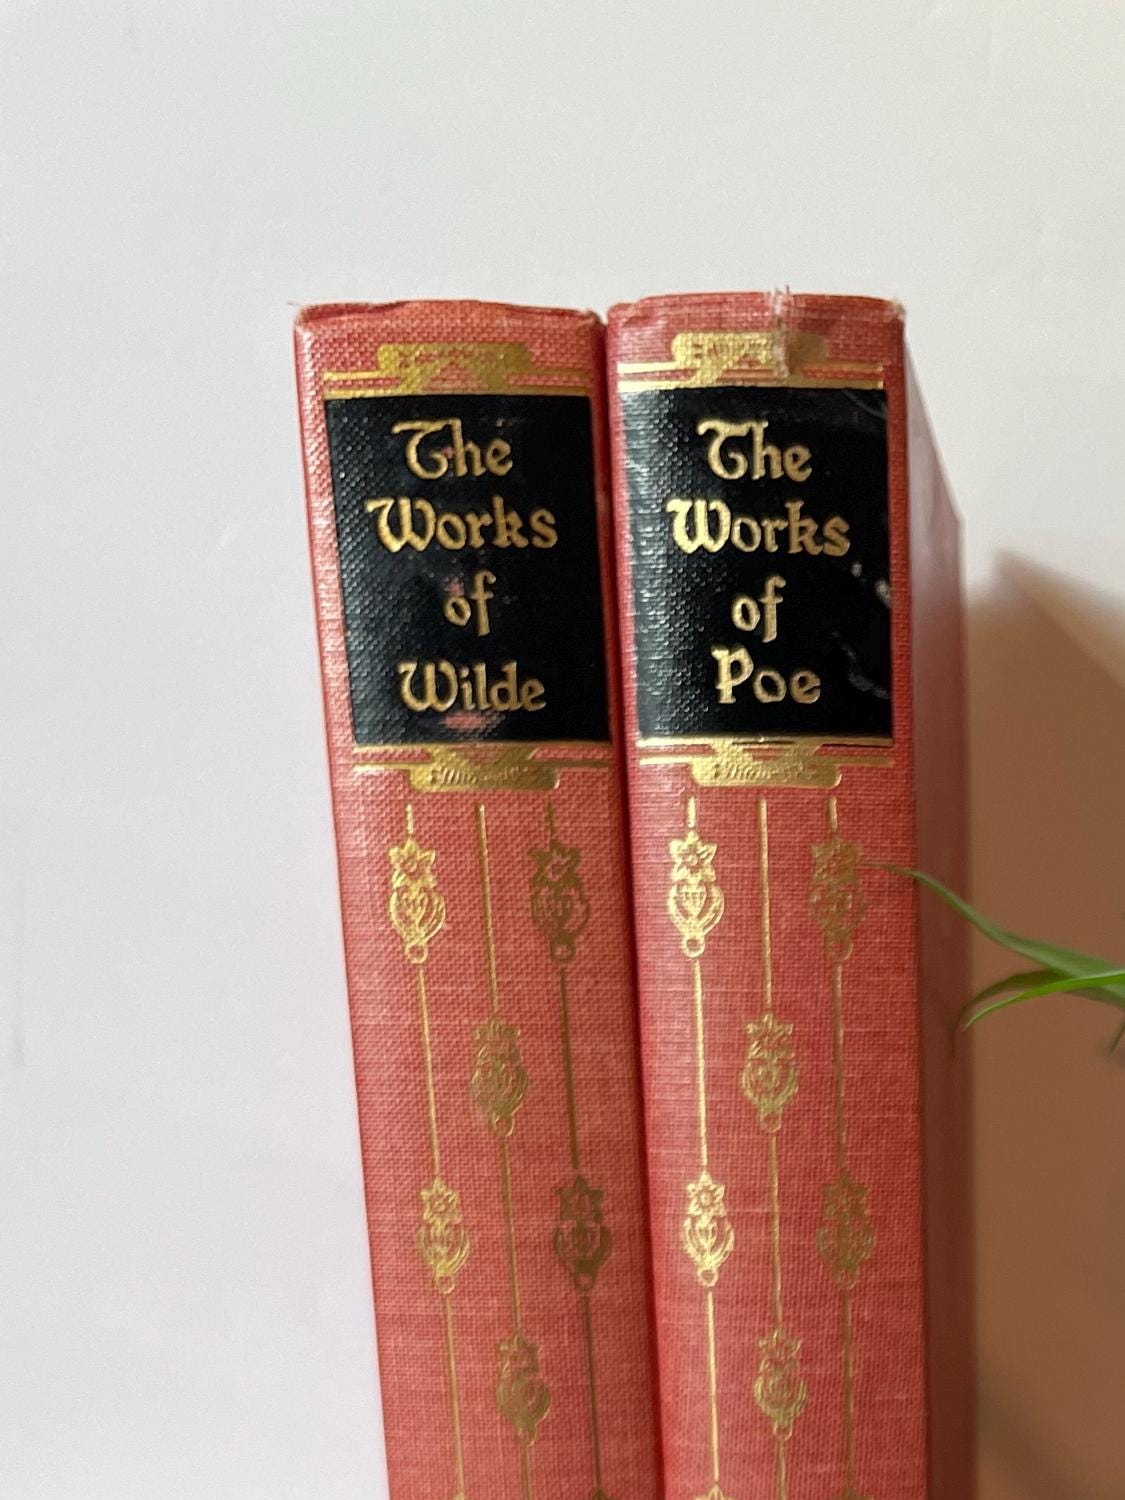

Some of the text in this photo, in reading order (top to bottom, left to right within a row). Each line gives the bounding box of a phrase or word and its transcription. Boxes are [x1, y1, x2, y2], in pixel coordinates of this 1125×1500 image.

[390, 418, 514, 480] The
[697, 420, 813, 481] The
[366, 496, 558, 553] Works
[667, 499, 850, 556] Works
[445, 570, 496, 635] of
[731, 576, 785, 643] of
[399, 660, 546, 712] Wilde
[711, 645, 821, 704] Poe
